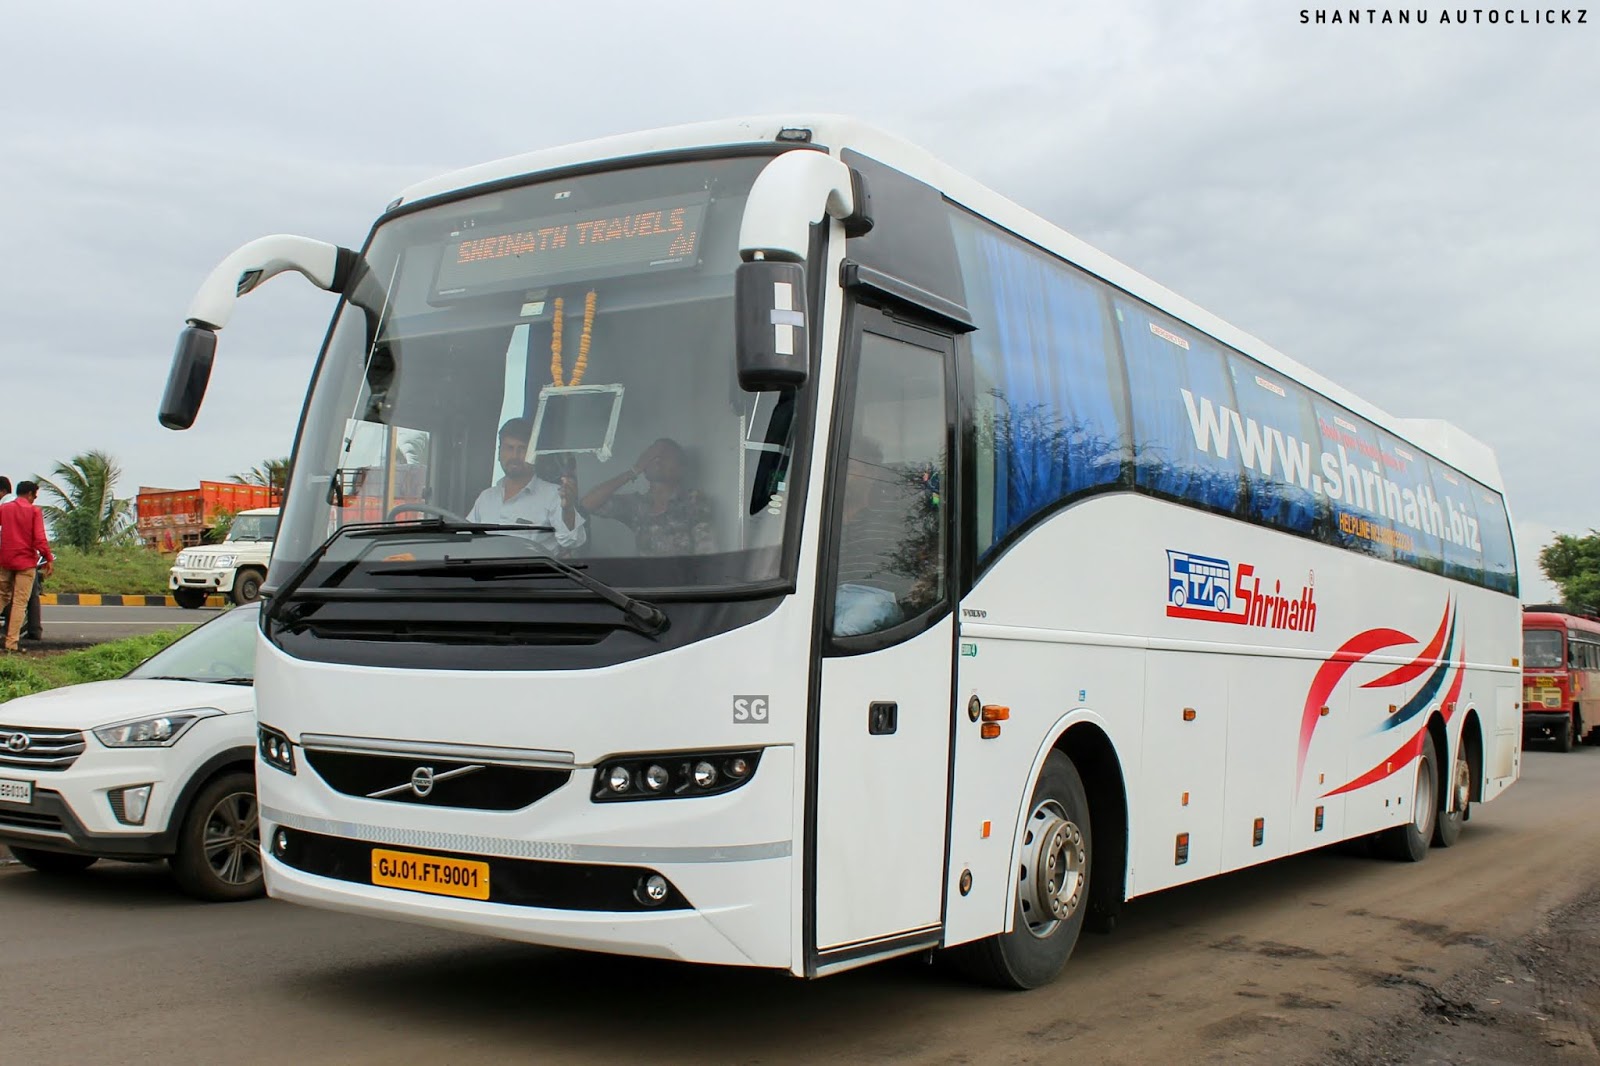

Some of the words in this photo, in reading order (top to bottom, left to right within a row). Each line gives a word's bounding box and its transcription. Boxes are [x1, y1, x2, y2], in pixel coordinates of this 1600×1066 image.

[575, 207, 686, 245] TRAVELS
[1235, 563, 1317, 632] Shrinath
[379, 857, 478, 888] GJ.01.FT.9001
